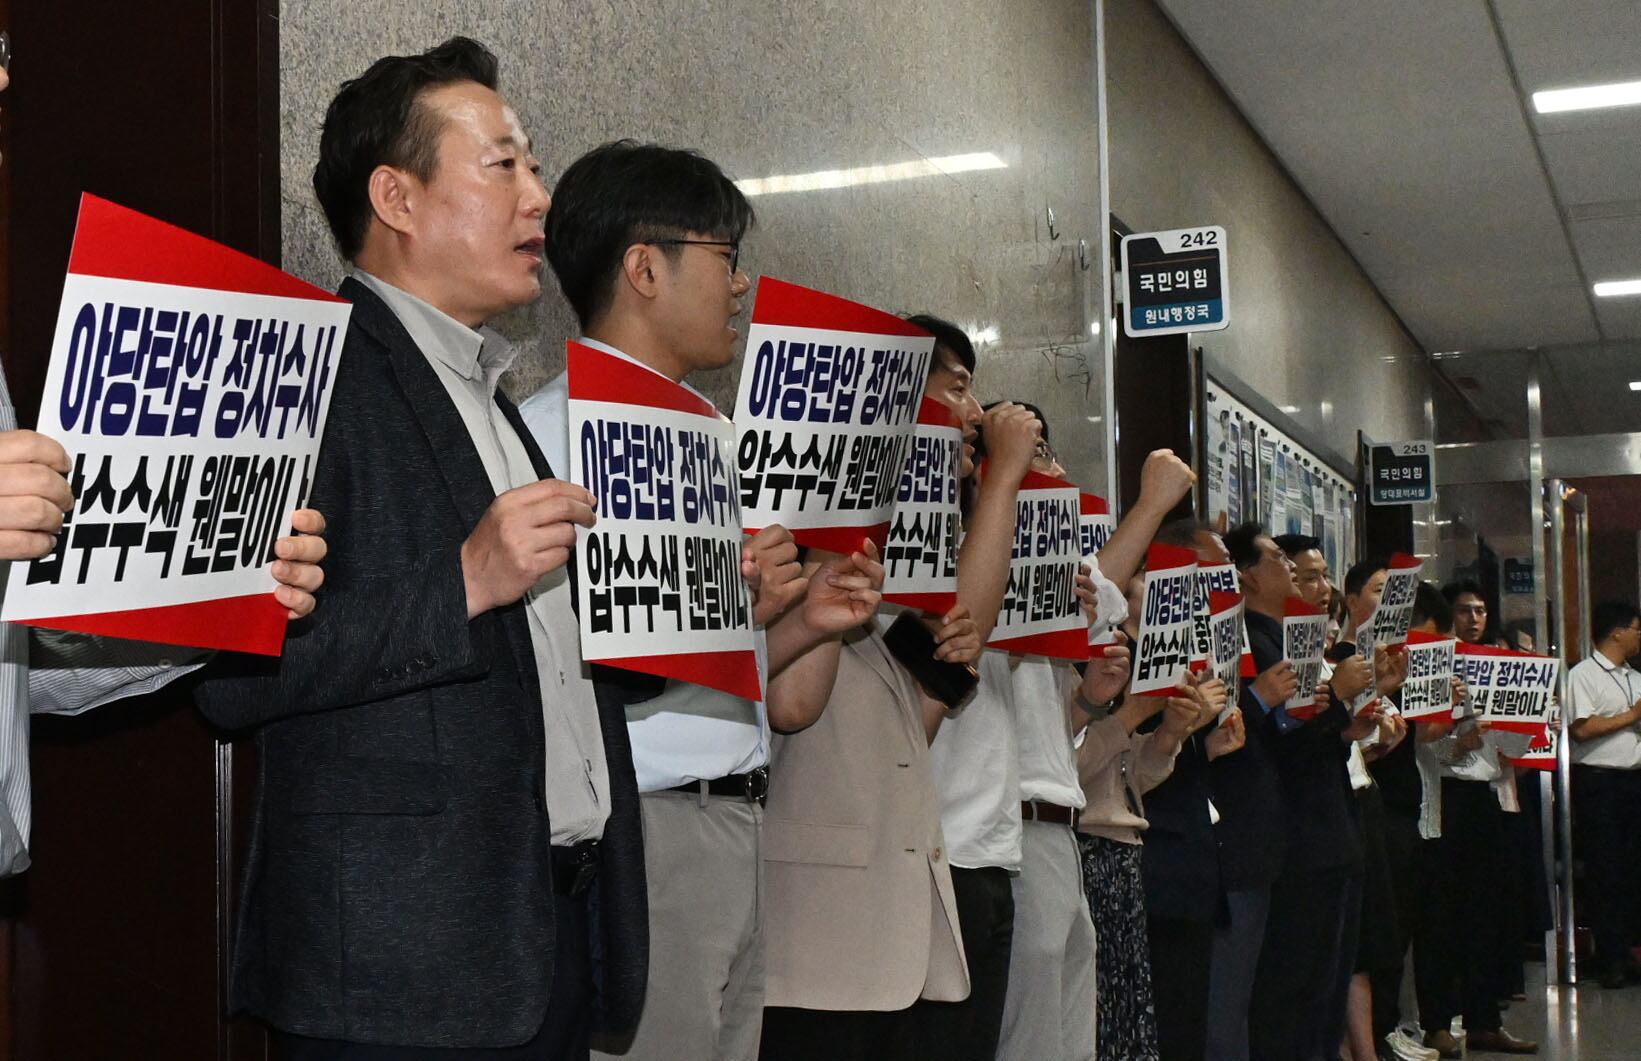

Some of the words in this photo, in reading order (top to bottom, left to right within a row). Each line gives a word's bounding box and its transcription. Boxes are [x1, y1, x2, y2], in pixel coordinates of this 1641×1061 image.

[1180, 231, 1217, 248] 242
[1140, 269, 1207, 292] 국민의힘
[1145, 304, 1209, 324] 원내행정국
[59, 302, 224, 438] 야당탄압
[214, 318, 337, 439] 정치수사
[748, 340, 865, 424] 야당탄압
[860, 350, 928, 425] 정치수사
[581, 419, 676, 522] 야당탄압
[678, 430, 741, 528] 정치수사
[737, 429, 848, 511] 압수수색
[837, 434, 911, 509] 웬말이냐
[897, 435, 945, 503] 당탄압
[1380, 466, 1423, 480] 국민의힘
[1403, 444, 1426, 454] 243
[887, 512, 942, 578] 수수색
[1037, 498, 1081, 557] 정치수사
[586, 532, 683, 634] 압수수색
[683, 536, 749, 631] 웬말이냐
[1146, 574, 1192, 626] 야당탄압
[1138, 626, 1190, 681] 압수수색
[1497, 662, 1553, 688] 정치수사
[1491, 689, 1547, 717] 웬말이냐
